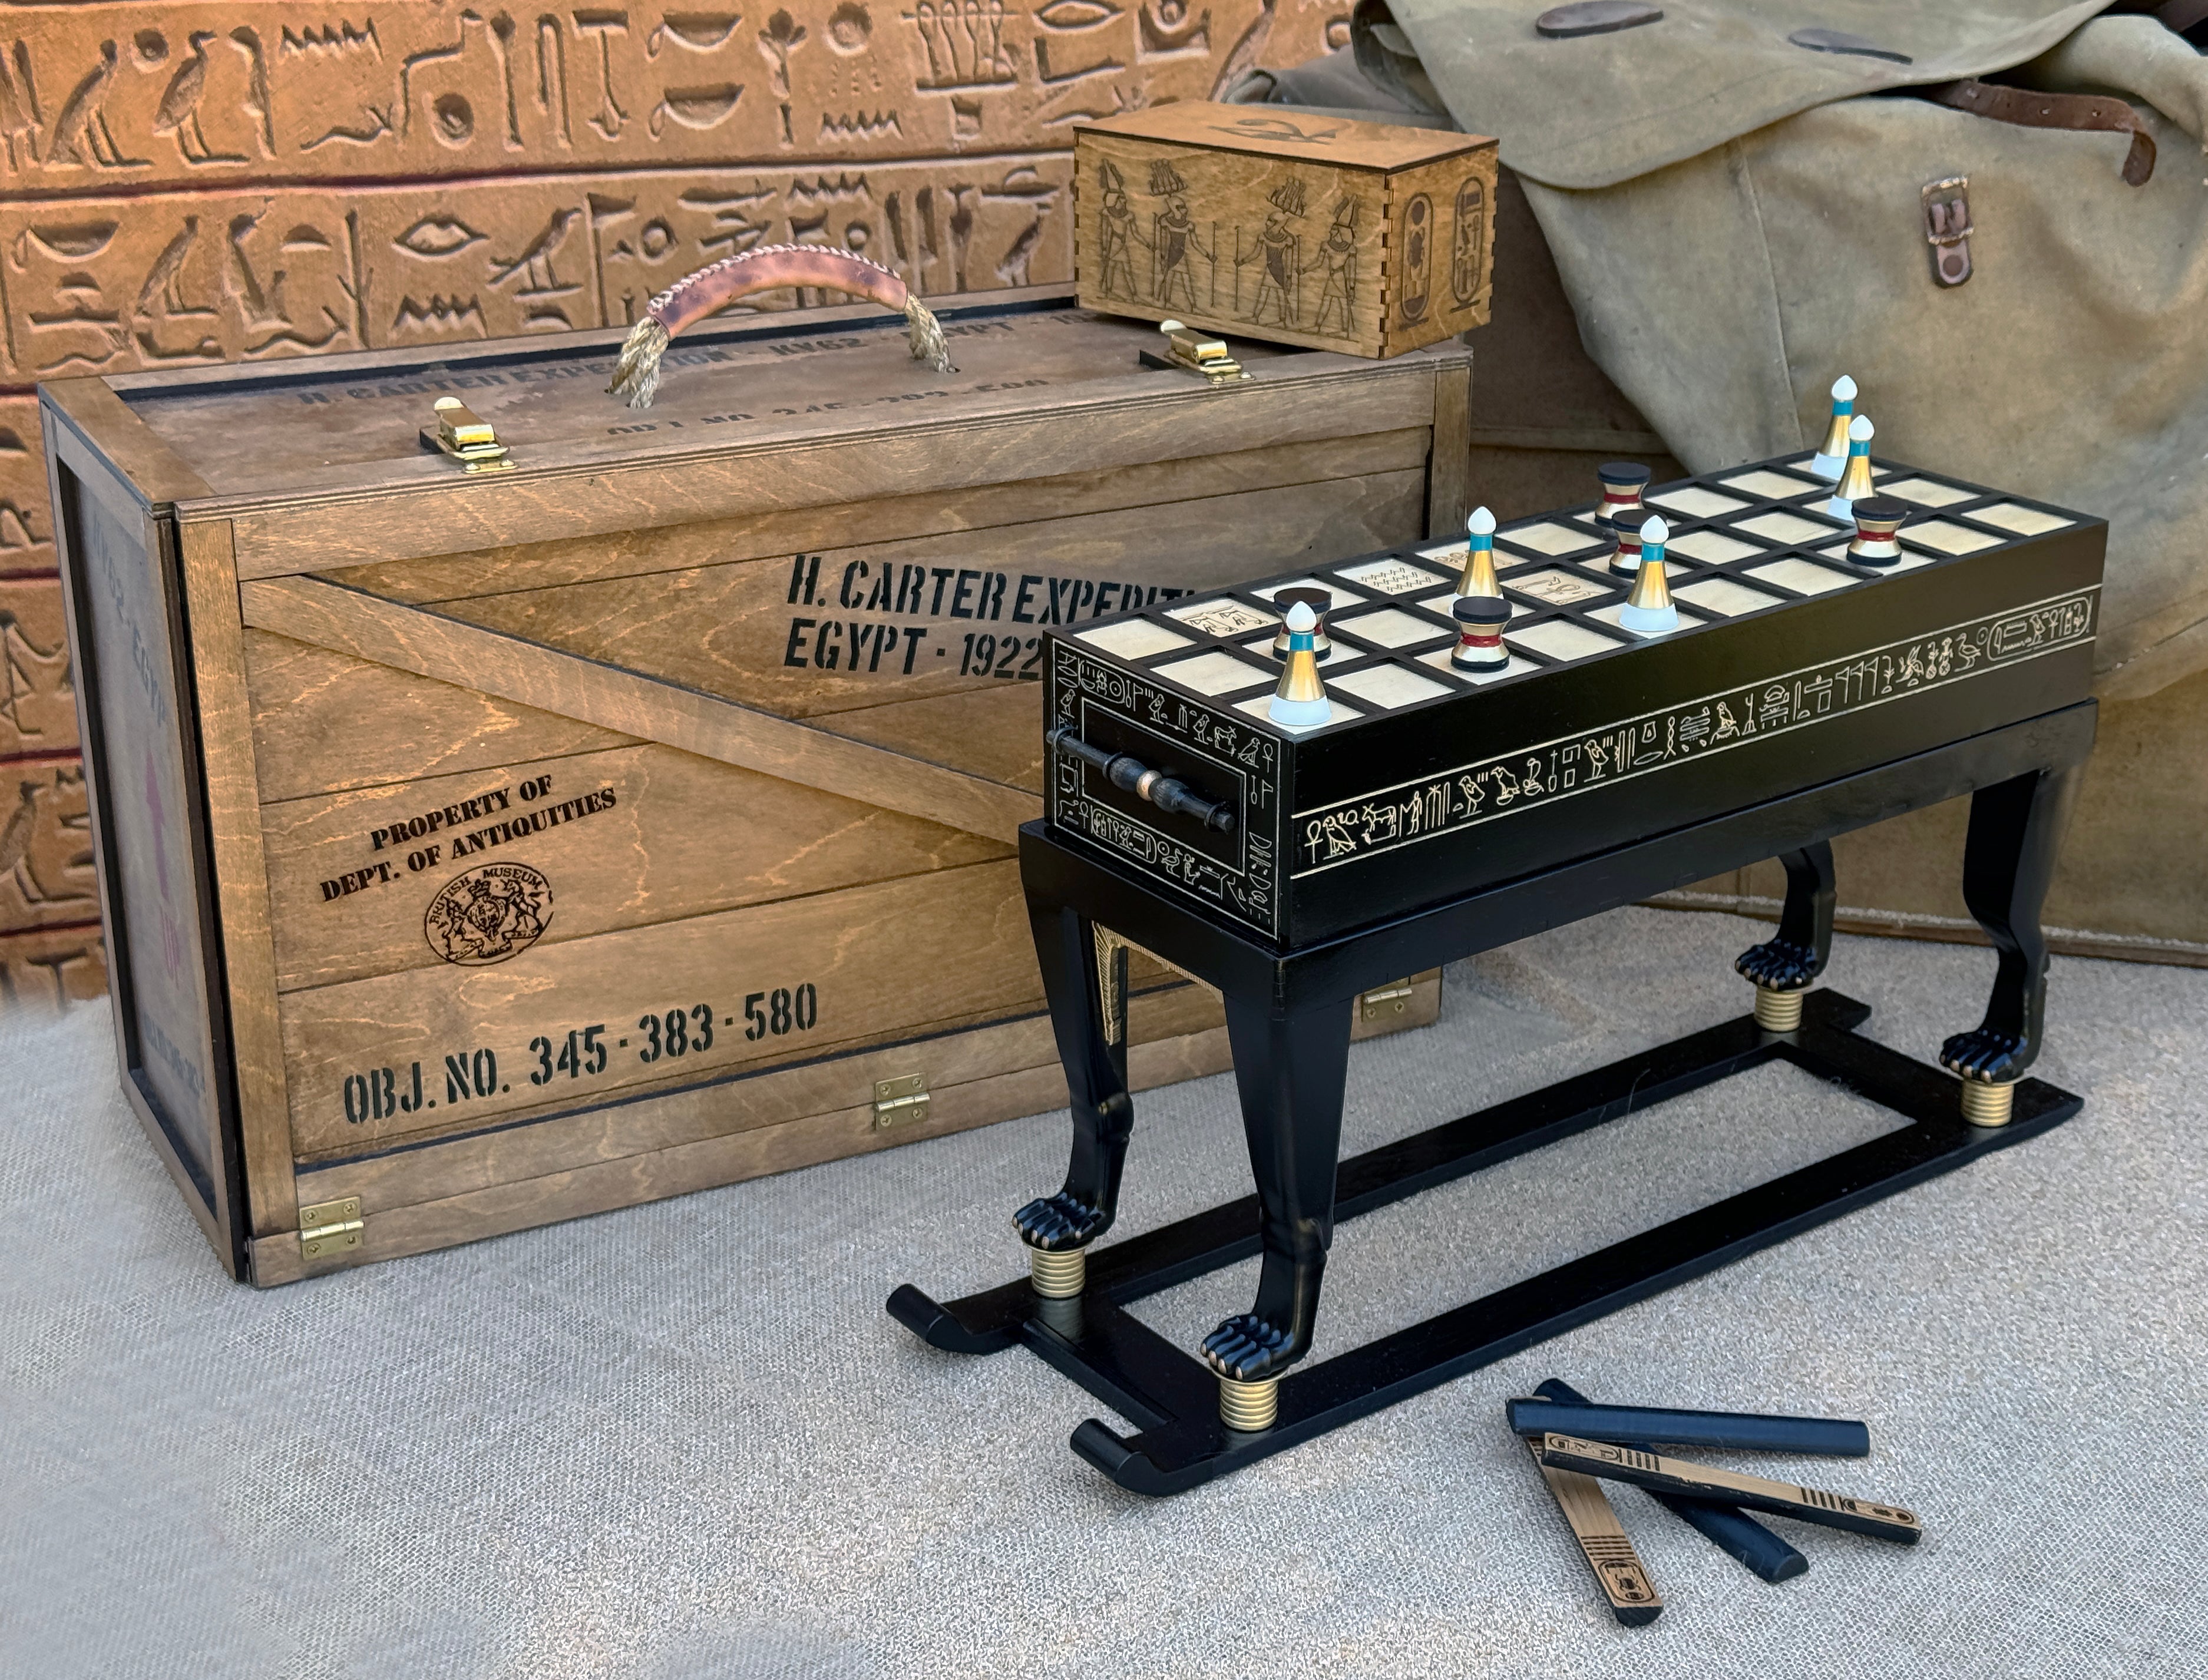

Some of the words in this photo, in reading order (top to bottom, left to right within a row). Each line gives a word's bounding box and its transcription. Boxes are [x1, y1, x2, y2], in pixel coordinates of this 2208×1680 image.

[787, 555, 826, 607] H.
[839, 560, 1007, 621] CARTER
[1012, 574, 1196, 626] EXPED
[784, 617, 927, 675] EGYPT
[960, 633, 1043, 679] 1922
[319, 862, 401, 902] DEPT.
[408, 845, 441, 872] OF
[451, 788, 617, 859] ANTIQUITIES
[371, 788, 510, 851] PROPERTY
[520, 775, 553, 801] OF
[429, 875, 472, 925] BRITISH
[482, 867, 544, 890] MUSEUM
[344, 1061, 437, 1124] OBJ.
[445, 1049, 510, 1104] NO.
